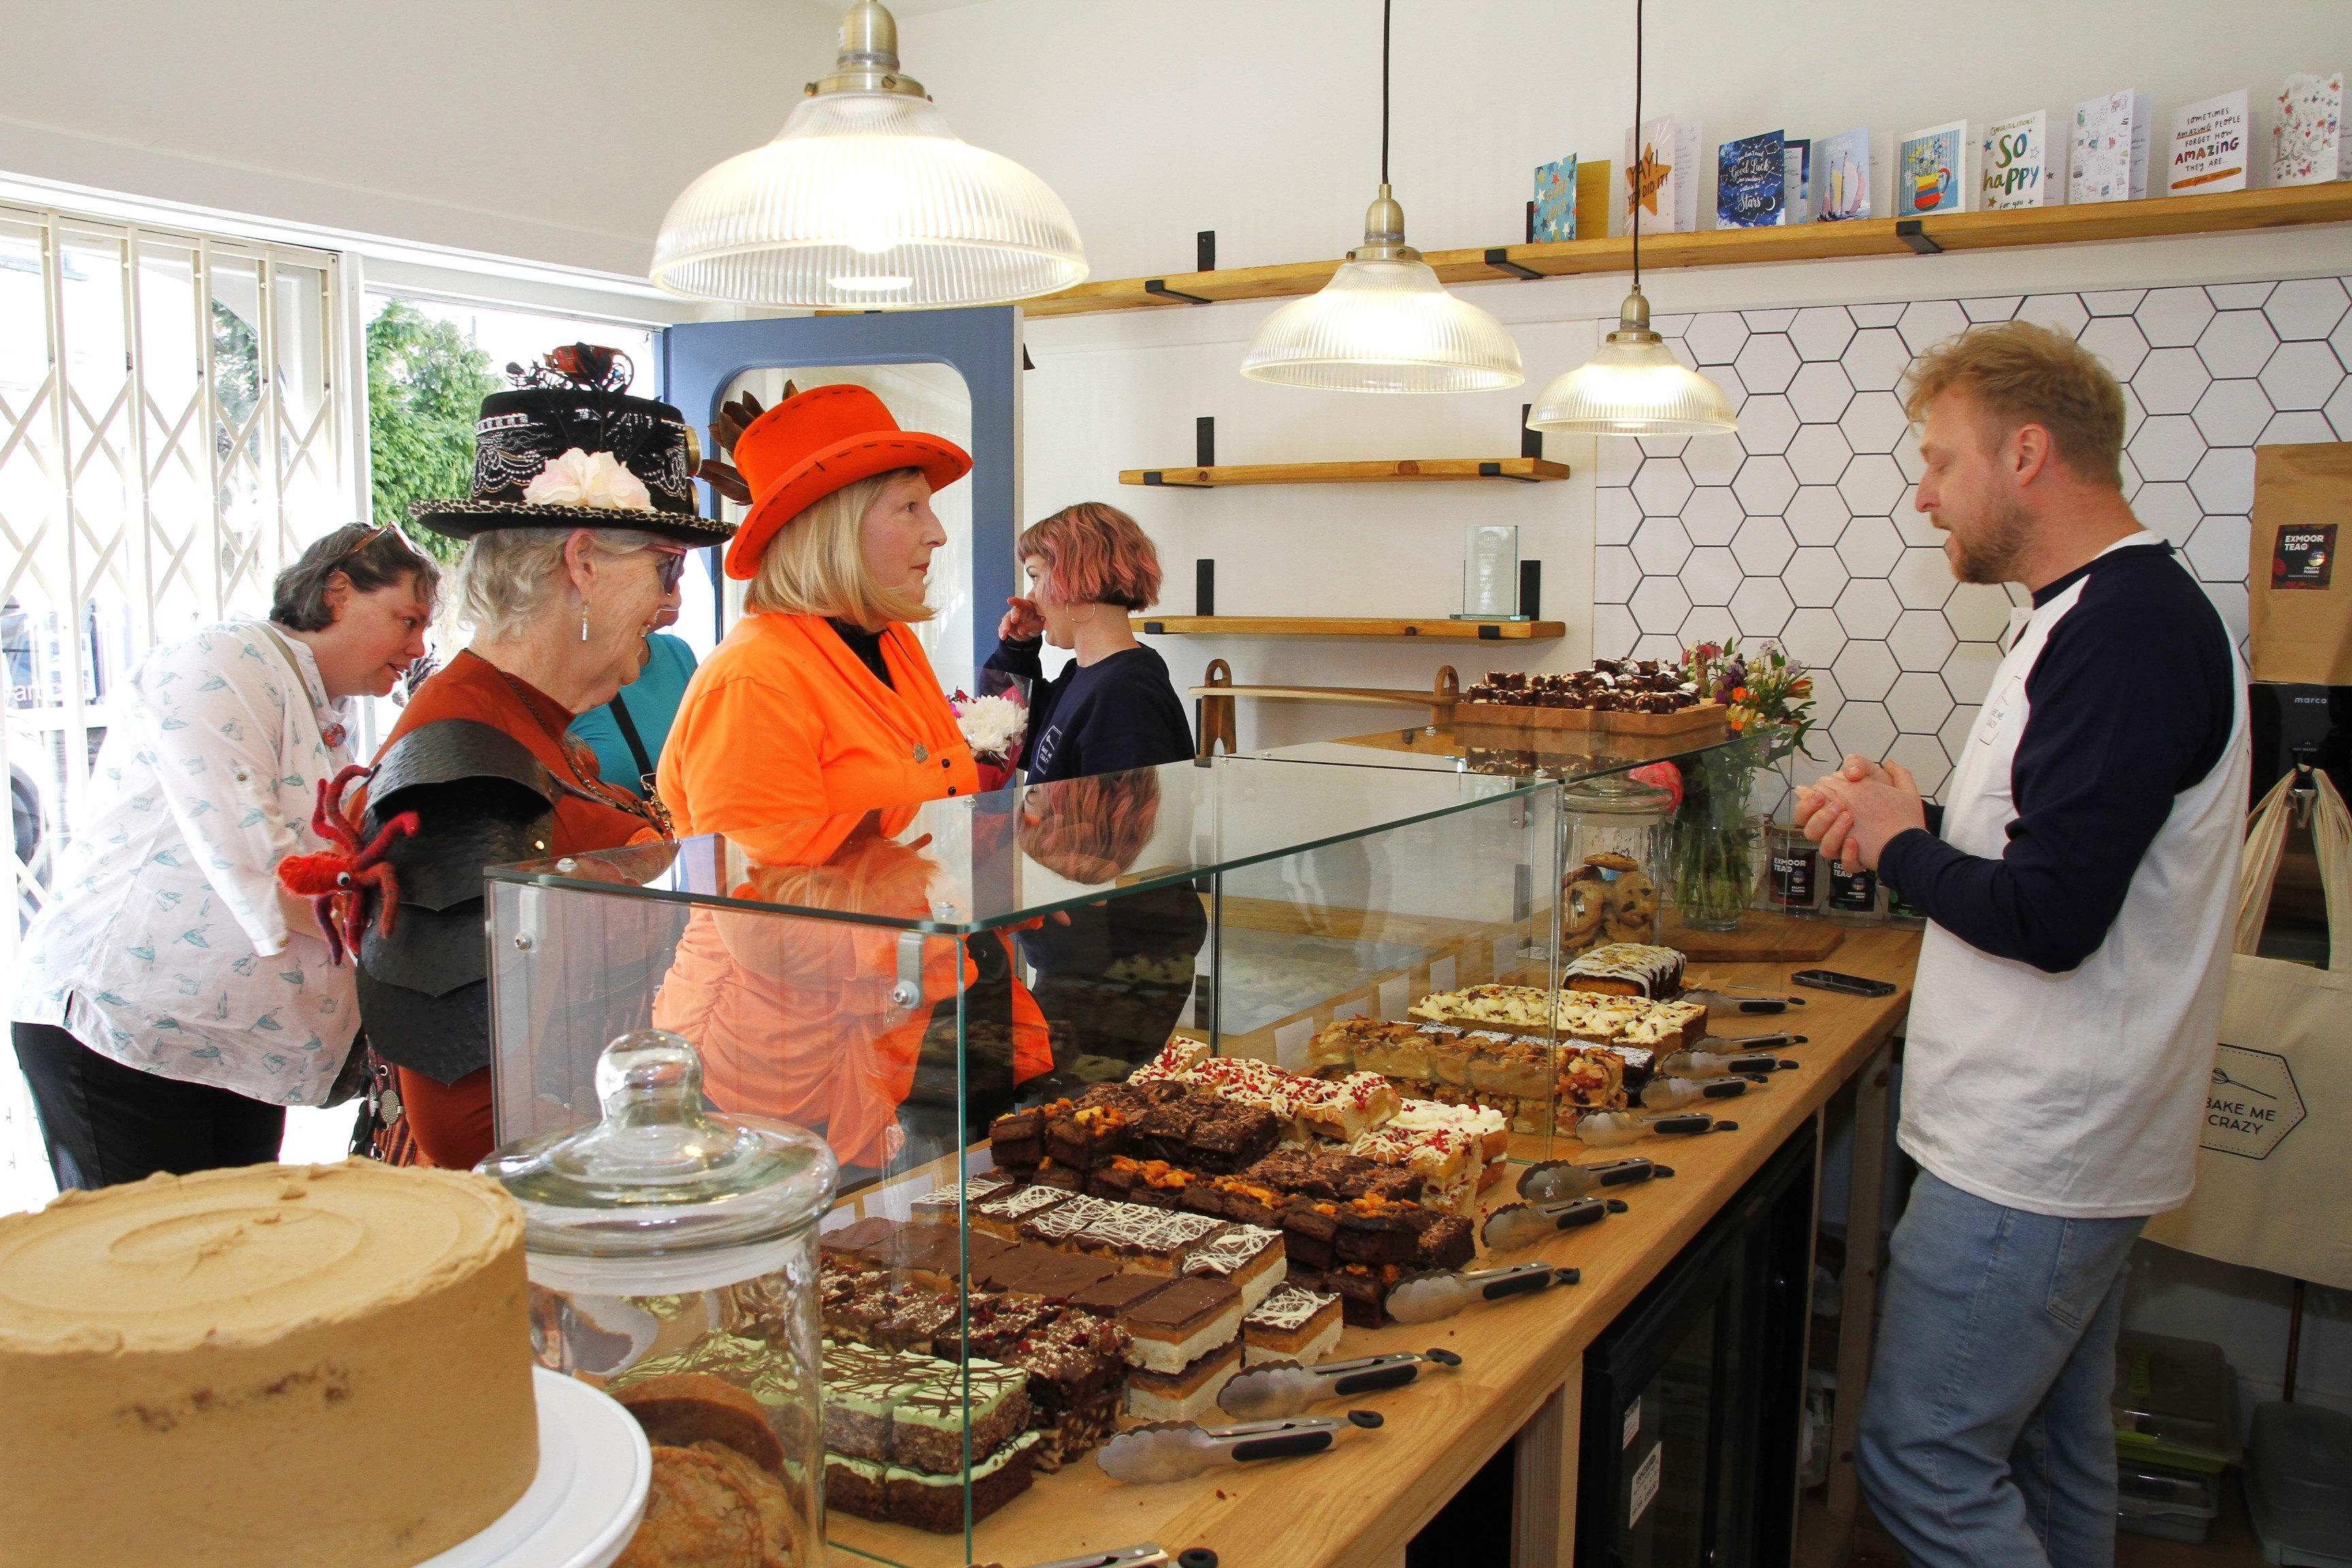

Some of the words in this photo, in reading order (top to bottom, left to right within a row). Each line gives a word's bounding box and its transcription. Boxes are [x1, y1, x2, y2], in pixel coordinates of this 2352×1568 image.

[2215, 115, 2240, 129] PEOPLE
[2185, 135, 2210, 147] FORGET
[2215, 130, 2233, 140] HOW
[1995, 133, 2027, 169] SO
[1729, 160, 1750, 182] Good
[1750, 157, 1769, 174] Luck
[2185, 163, 2204, 172] THEY
[1642, 181, 1654, 197] DID
[1657, 173, 1668, 189] IT!
[1737, 192, 1761, 212] Stars
[1999, 201, 2010, 210] for
[2012, 200, 2023, 210] you
[2285, 534, 2324, 542] EXMOOR
[1774, 858, 1806, 866] EXMOOR
[2250, 1107, 2276, 1122] ME
[2208, 1114, 2264, 1134] CRAZY
